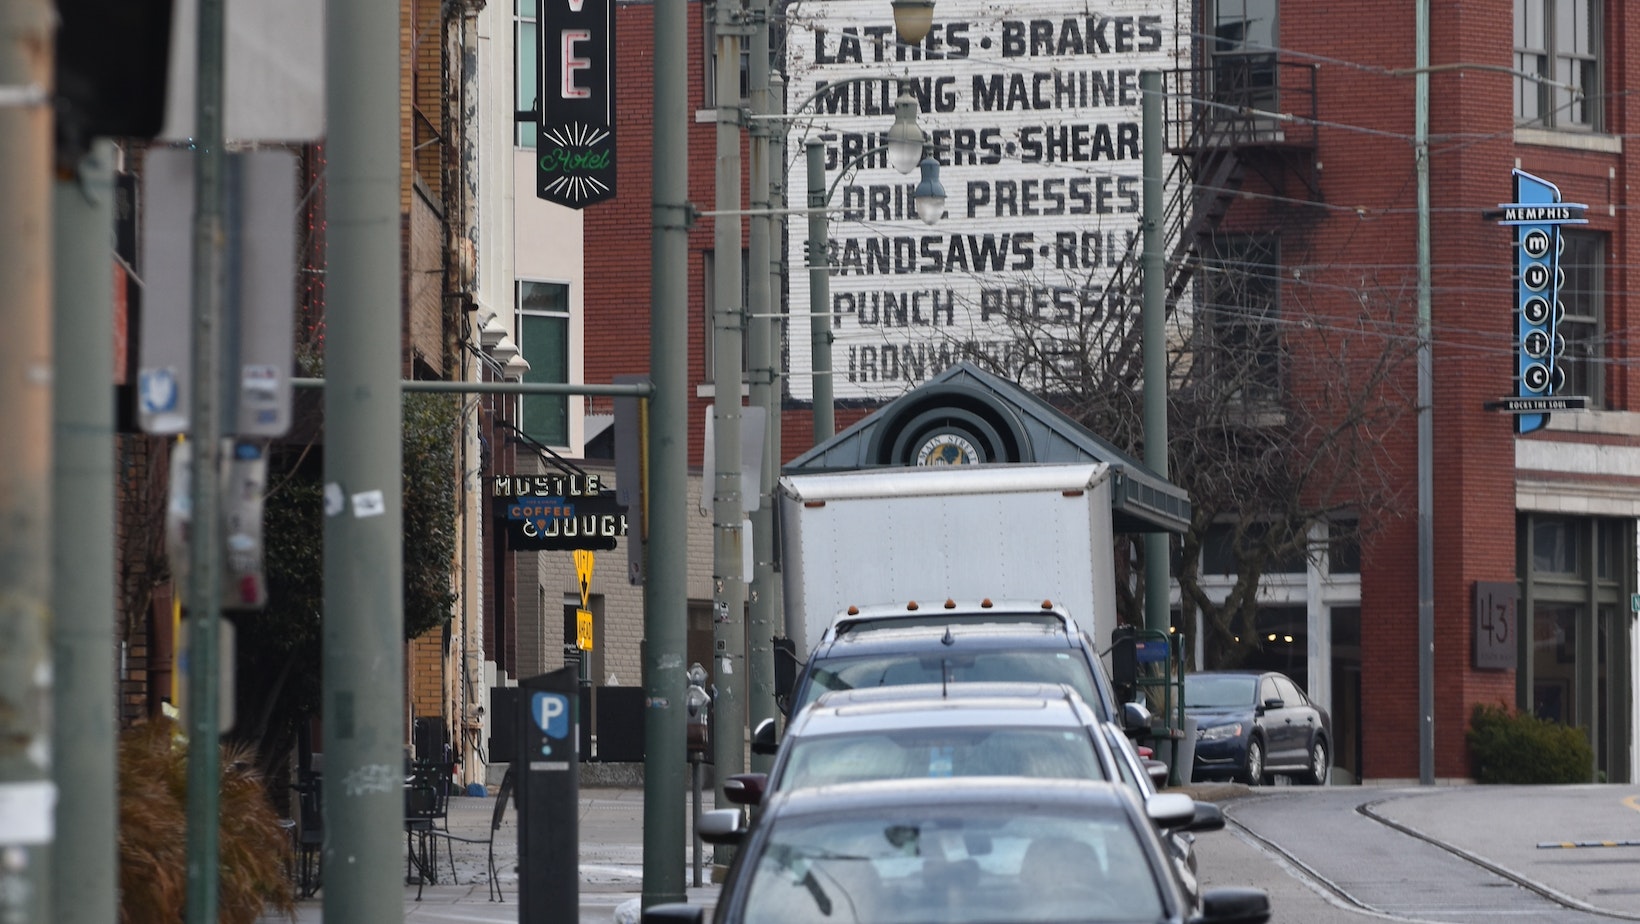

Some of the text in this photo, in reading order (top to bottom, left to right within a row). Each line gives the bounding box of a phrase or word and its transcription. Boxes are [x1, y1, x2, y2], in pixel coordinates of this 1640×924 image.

[815, 15, 1162, 64] LATHES BRAKES
[972, 69, 1164, 111] MACHINE
[540, 147, 610, 173] Hotel
[820, 127, 1001, 170] GRIERS
[843, 176, 1140, 221] DRIL PRESSES
[1506, 207, 1570, 220] MEMPHIS
[827, 232, 1034, 276] BANDSAWS
[833, 290, 954, 329] PUNCH
[1527, 236, 1547, 385] music
[1508, 400, 1533, 410] ROCKS
[1534, 400, 1547, 410] THE
[918, 435, 978, 462] MAIN STREET
[511, 506, 572, 518] COFFEE
[1480, 593, 1509, 647] 43
[541, 696, 564, 731] P
